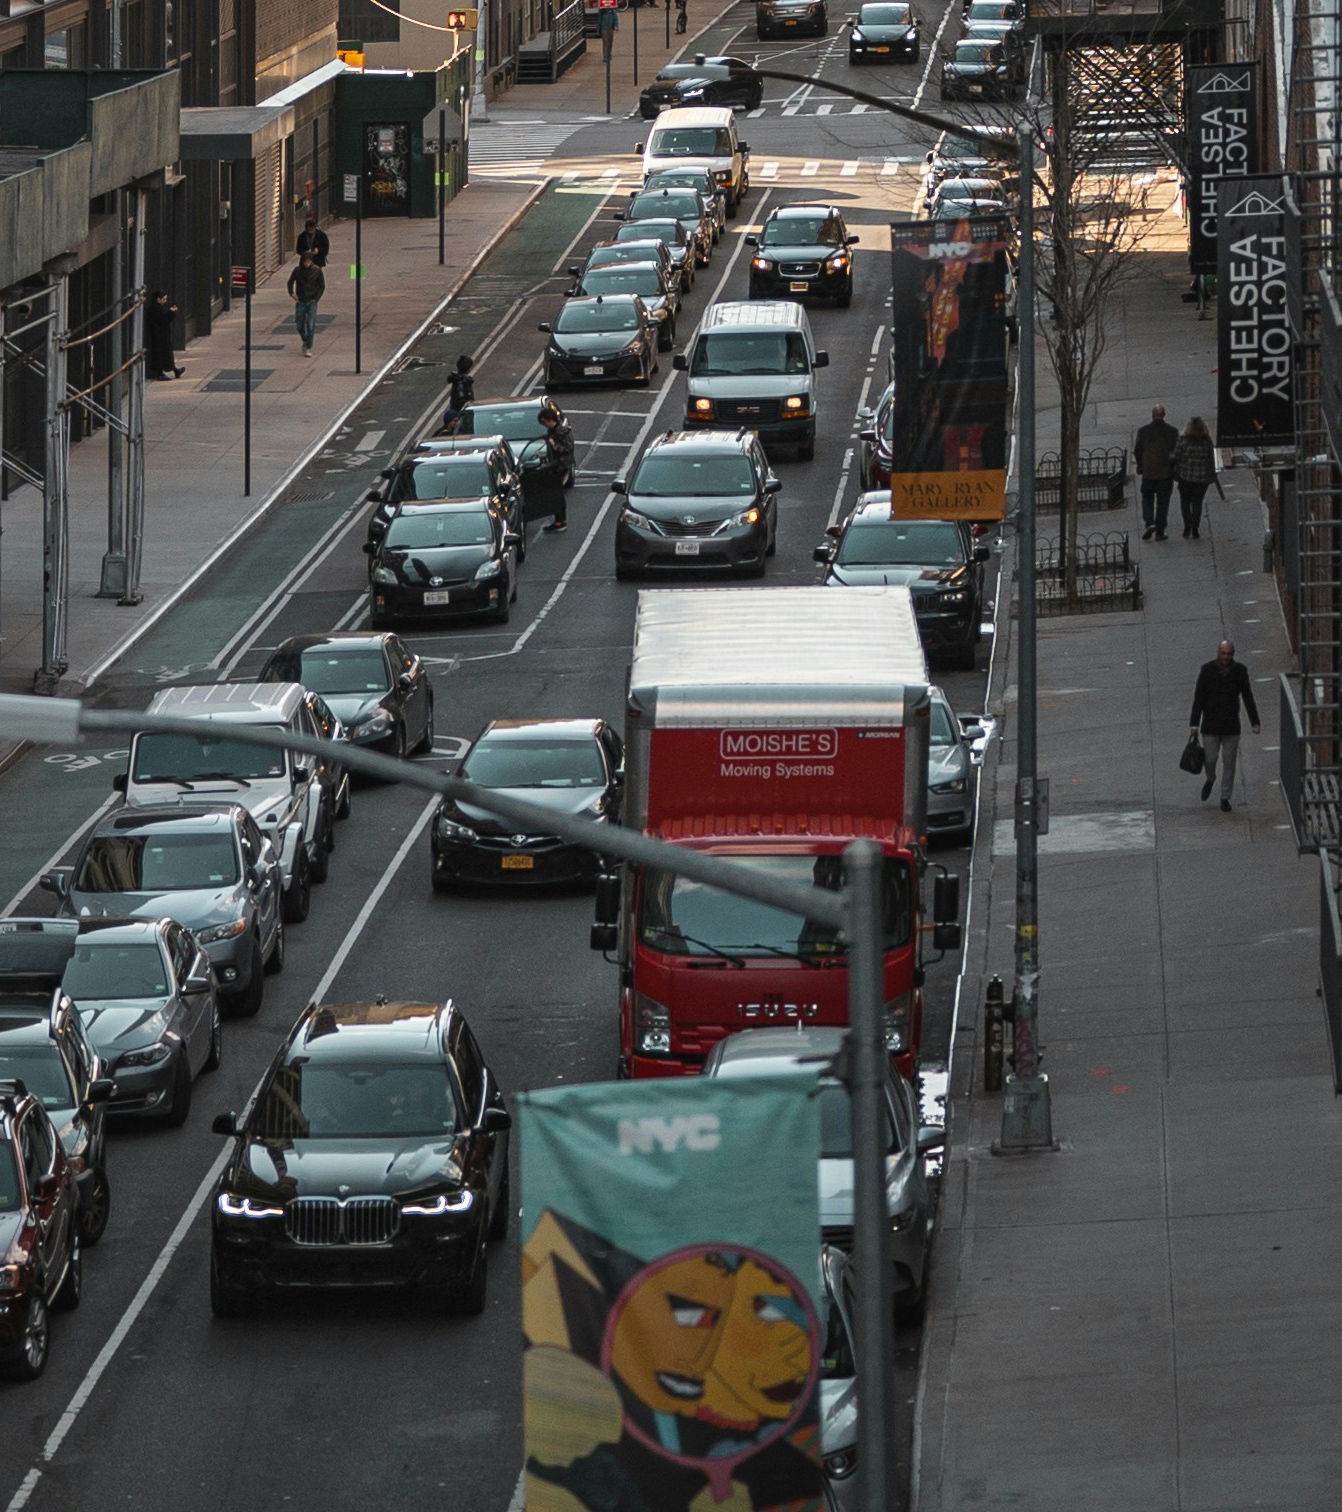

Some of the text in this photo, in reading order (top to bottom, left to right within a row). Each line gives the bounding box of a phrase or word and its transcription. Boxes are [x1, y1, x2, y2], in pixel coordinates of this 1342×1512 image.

[929, 242, 973, 258] NYC
[1230, 234, 1290, 404] CHELSEA FACTORY
[901, 481, 996, 497] MARY RYAN
[912, 495, 985, 510] GALLERY
[726, 734, 831, 753] MOISHE'S
[721, 763, 835, 779] Moving Systems
[737, 1003, 818, 1018] ISUZU
[618, 1114, 721, 1155] NYC
